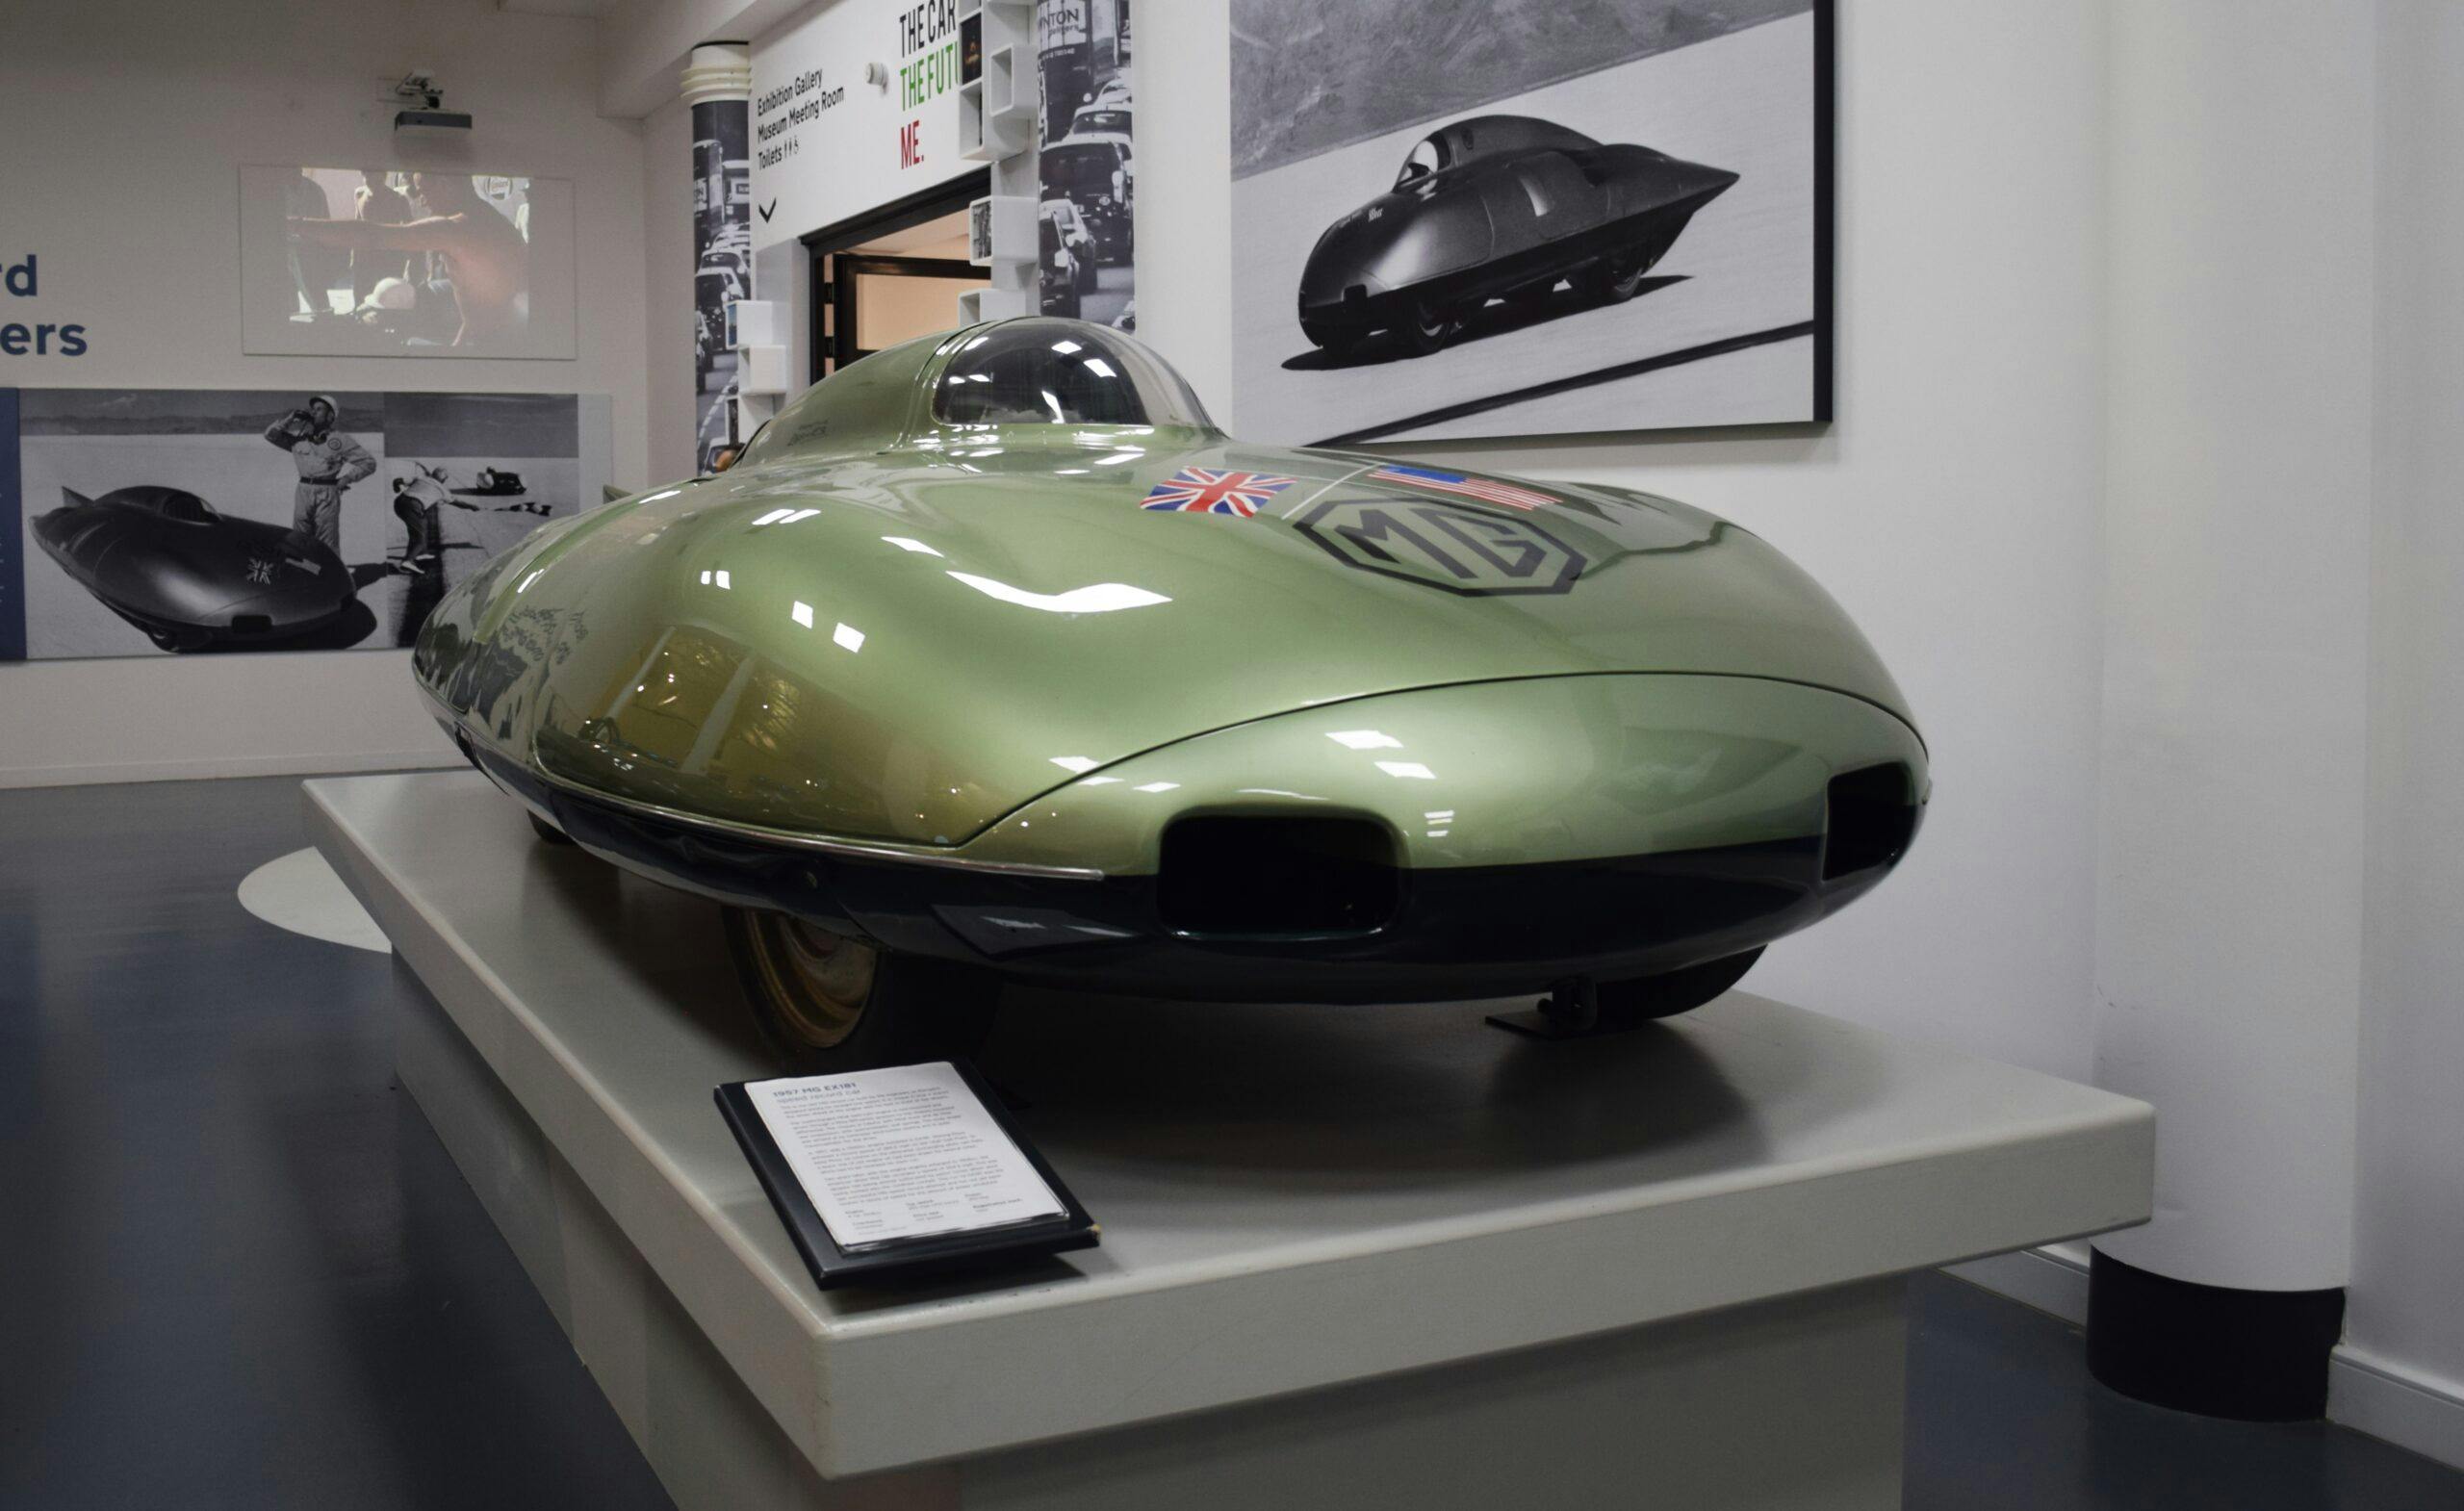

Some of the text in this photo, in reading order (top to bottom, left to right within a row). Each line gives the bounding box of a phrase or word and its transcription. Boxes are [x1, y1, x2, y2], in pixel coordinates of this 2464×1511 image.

[900, 0, 957, 58] THE CAR
[757, 68, 823, 117] Exhibition Gallery
[900, 59, 925, 112] THE
[757, 87, 844, 144] Museum Meeting Room
[757, 145, 783, 171] Toilets
[901, 119, 925, 170] ME.
[1332, 506, 1548, 579] MG
